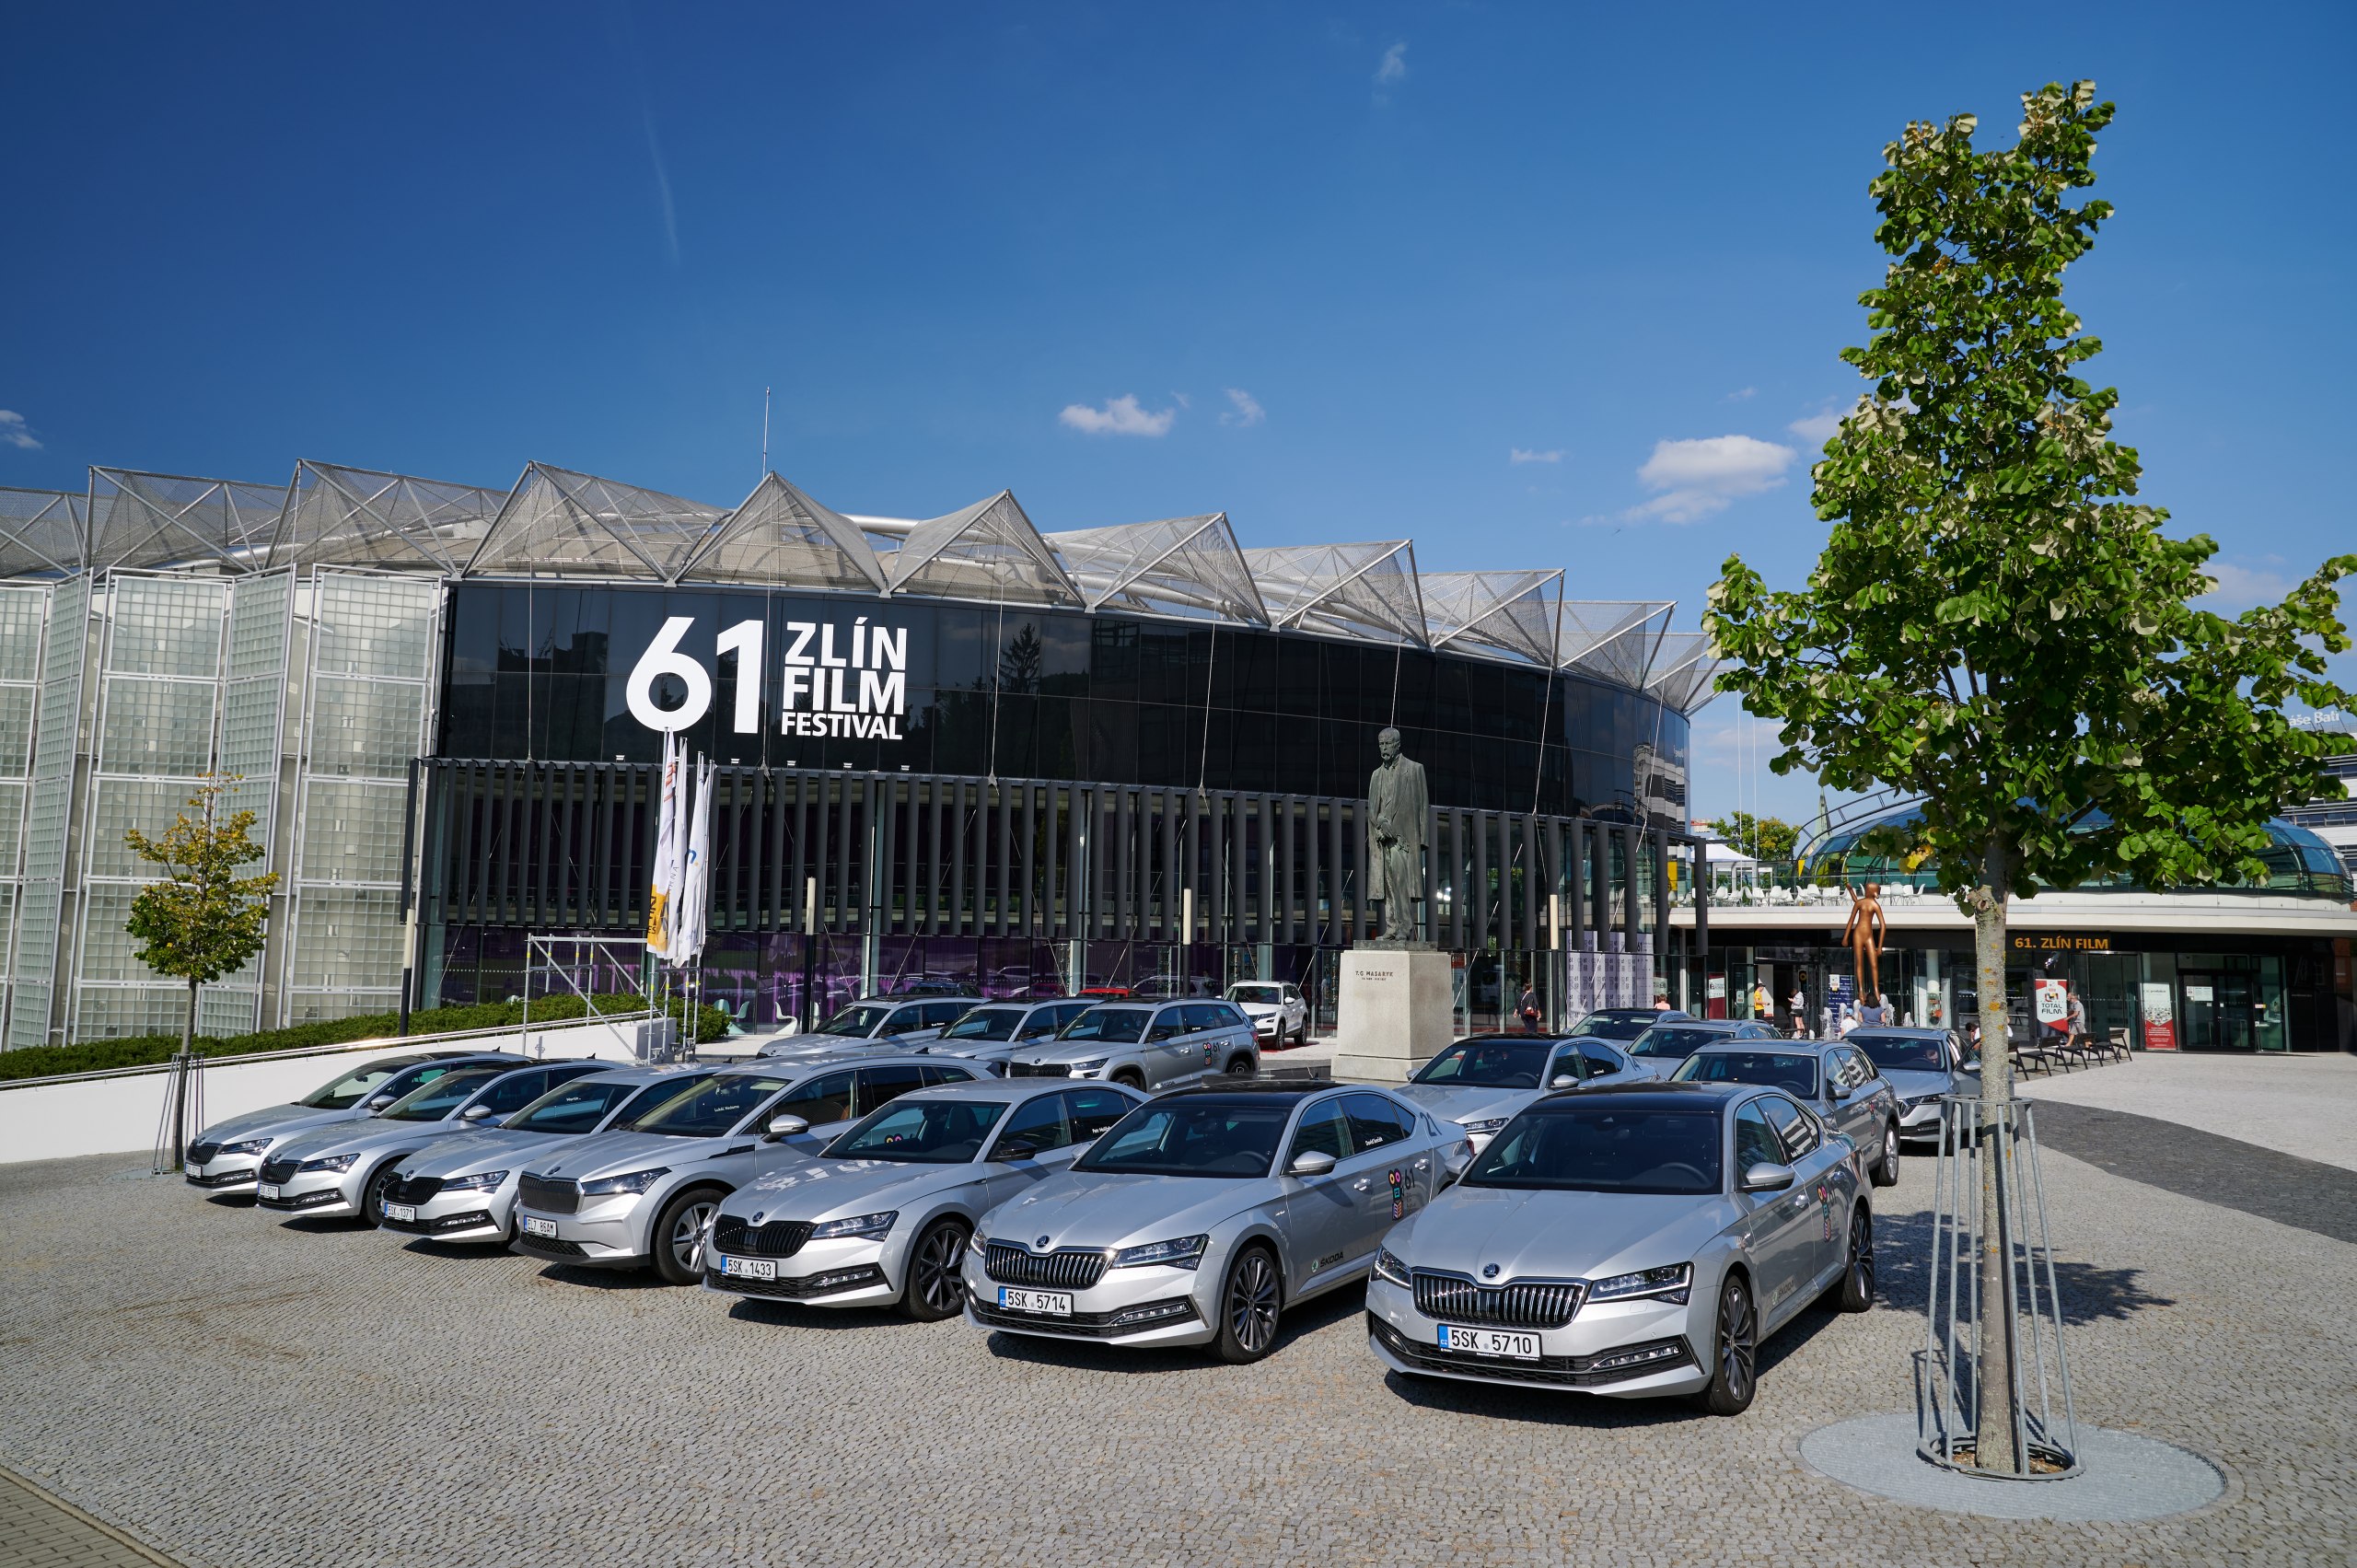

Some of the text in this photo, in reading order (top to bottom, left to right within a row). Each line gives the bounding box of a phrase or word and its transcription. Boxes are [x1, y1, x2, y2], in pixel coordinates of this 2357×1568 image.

[784, 616, 908, 670] ZLÍN
[626, 616, 763, 734] 61
[783, 666, 906, 715] FILM
[782, 712, 903, 740] FESTIVAL
[2289, 714, 2311, 726] áše
[2014, 935, 2108, 949] 61. ZLÍN FILM
[400, 1207, 412, 1218] 1371
[528, 1218, 537, 1231] EL7
[727, 1259, 772, 1276] 5SK 1433
[1007, 1291, 1028, 1308] 5SK
[1037, 1295, 1066, 1312] 5714
[1451, 1329, 1480, 1350] 5SK
[1492, 1333, 1532, 1354] 5710
